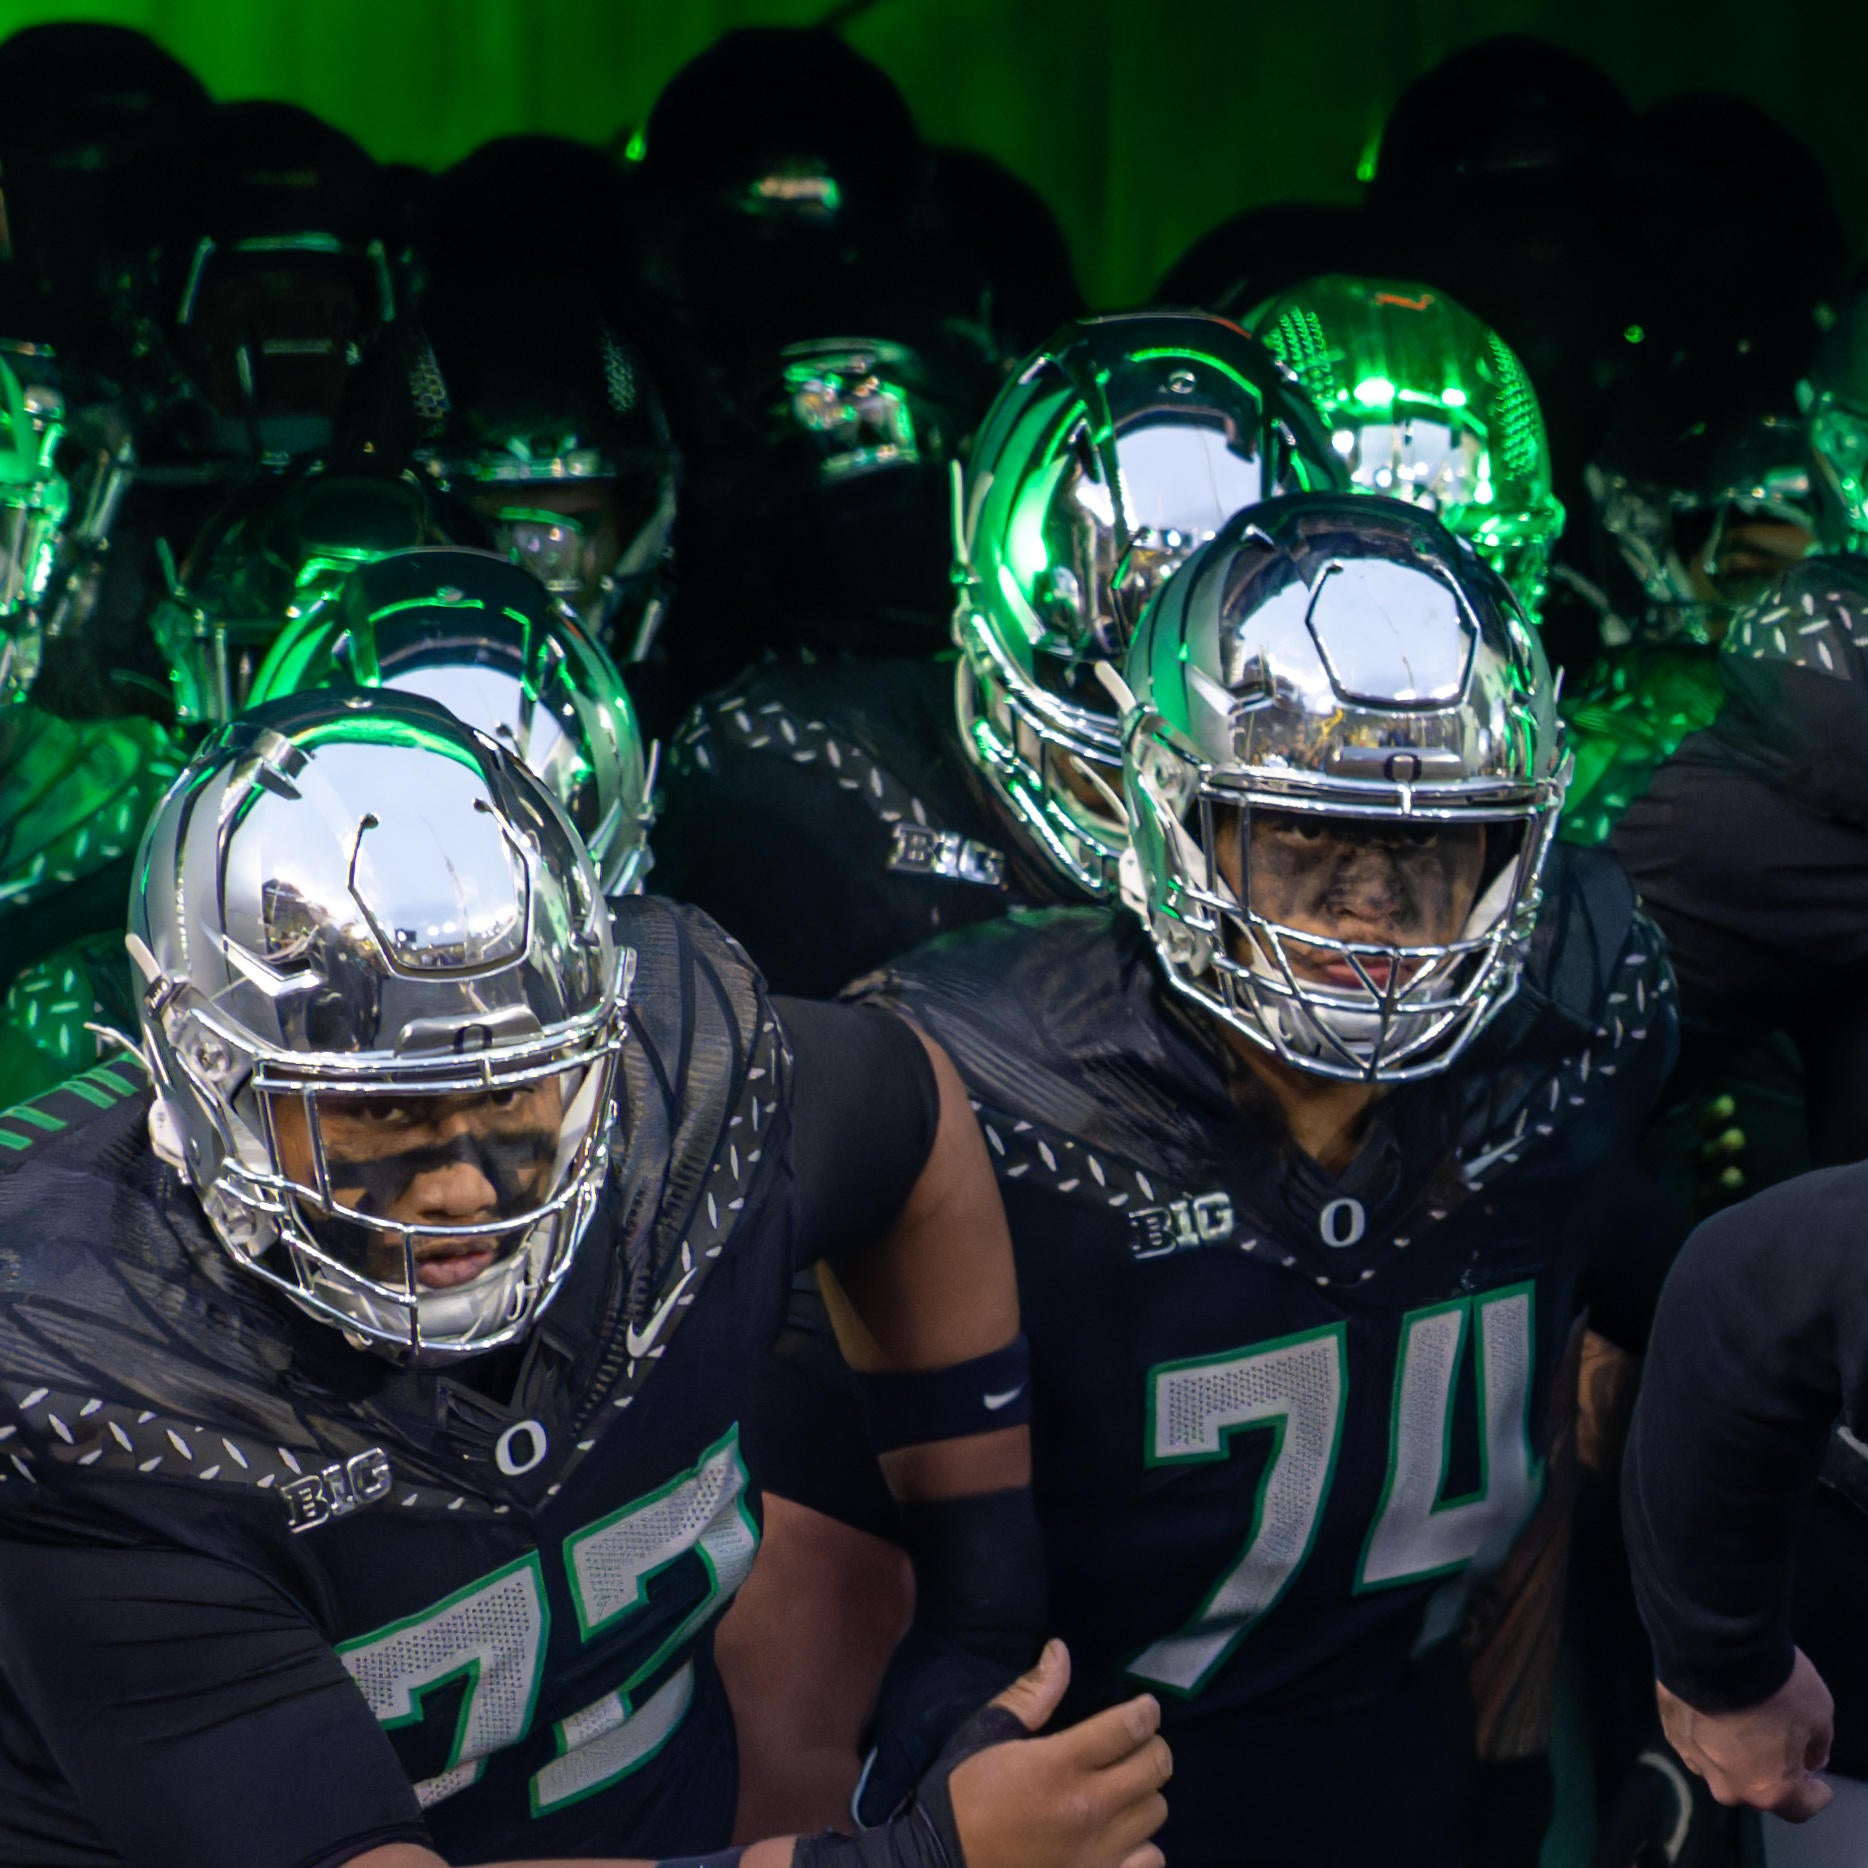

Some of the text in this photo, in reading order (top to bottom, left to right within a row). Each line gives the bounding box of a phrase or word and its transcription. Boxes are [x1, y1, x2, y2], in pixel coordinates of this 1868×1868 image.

[1320, 1197, 1366, 1248] O
[495, 1419, 549, 1476] O
[1130, 1278, 1546, 1700] 74
